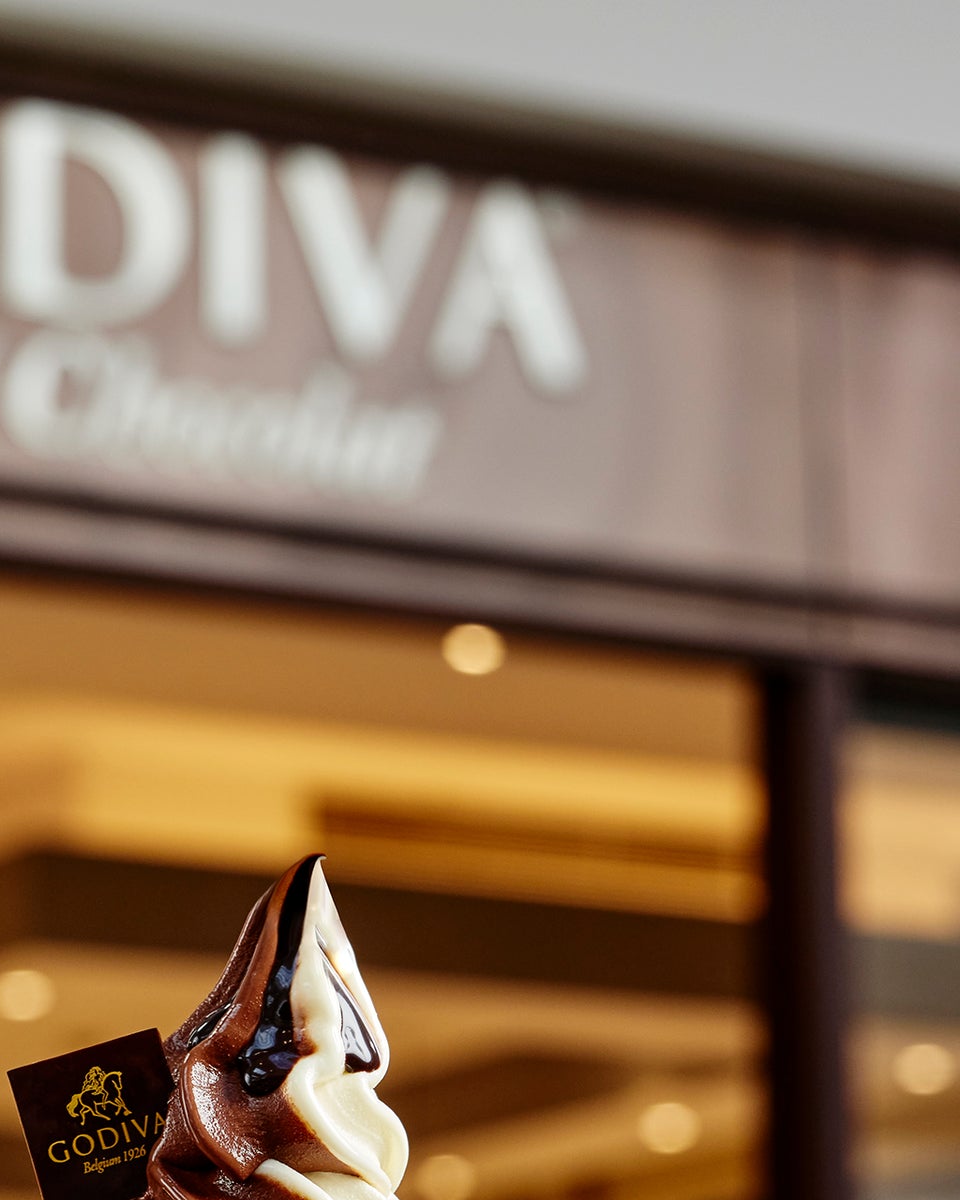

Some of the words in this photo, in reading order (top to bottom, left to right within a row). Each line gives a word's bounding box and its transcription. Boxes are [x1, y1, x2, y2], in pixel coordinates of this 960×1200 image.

[48, 1111, 166, 1164] GODIVA
[83, 1157, 121, 1174] Belgium
[123, 1145, 147, 1163] 1926
